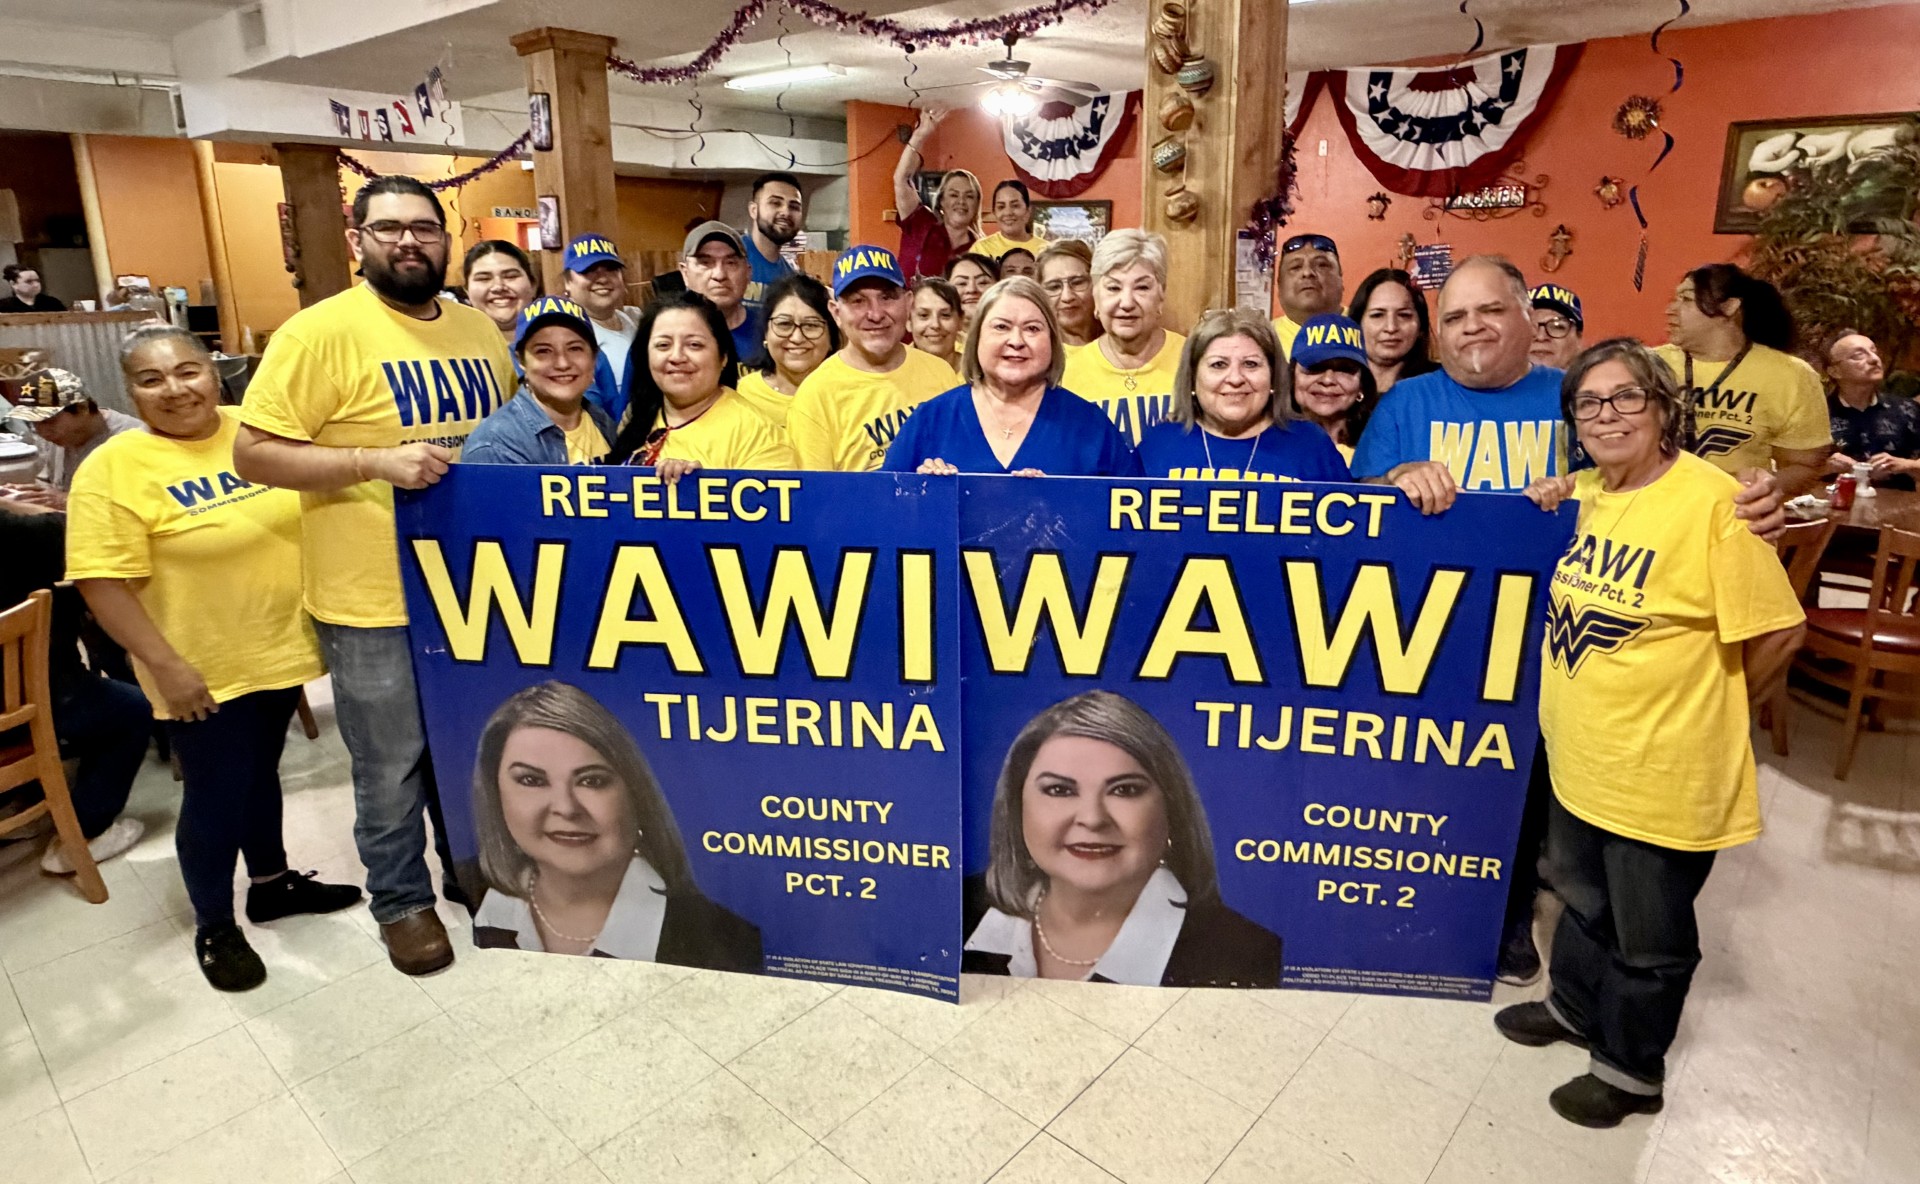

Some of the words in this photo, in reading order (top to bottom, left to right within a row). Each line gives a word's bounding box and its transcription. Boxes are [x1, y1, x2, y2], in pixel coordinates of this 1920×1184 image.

[837, 250, 894, 279] WAWI
[523, 298, 586, 322] WAWI
[1306, 324, 1363, 350] WAWI
[381, 358, 503, 427] WAWI
[1745, 414, 1754, 426] 2
[1429, 419, 1569, 491] WAWI
[540, 474, 801, 522] RE-ELECT
[1110, 487, 1396, 538] RE-ELECT
[411, 537, 935, 683] WAWI
[1599, 583, 1627, 605] Pct.
[1631, 592, 1645, 609] 2
[962, 548, 1533, 703] WAWI
[644, 692, 945, 753] TIJERINA
[1195, 700, 1516, 771] TIJERINA
[760, 795, 894, 825] COUNTY
[1303, 803, 1448, 837] COUNTY
[702, 831, 951, 869] COMMISSIONER
[1234, 838, 1502, 880] COMMISSIONER
[785, 872, 852, 898] PCT.
[859, 877, 878, 900] 2
[1317, 879, 1388, 906] PCT.
[1396, 886, 1416, 908] 2
